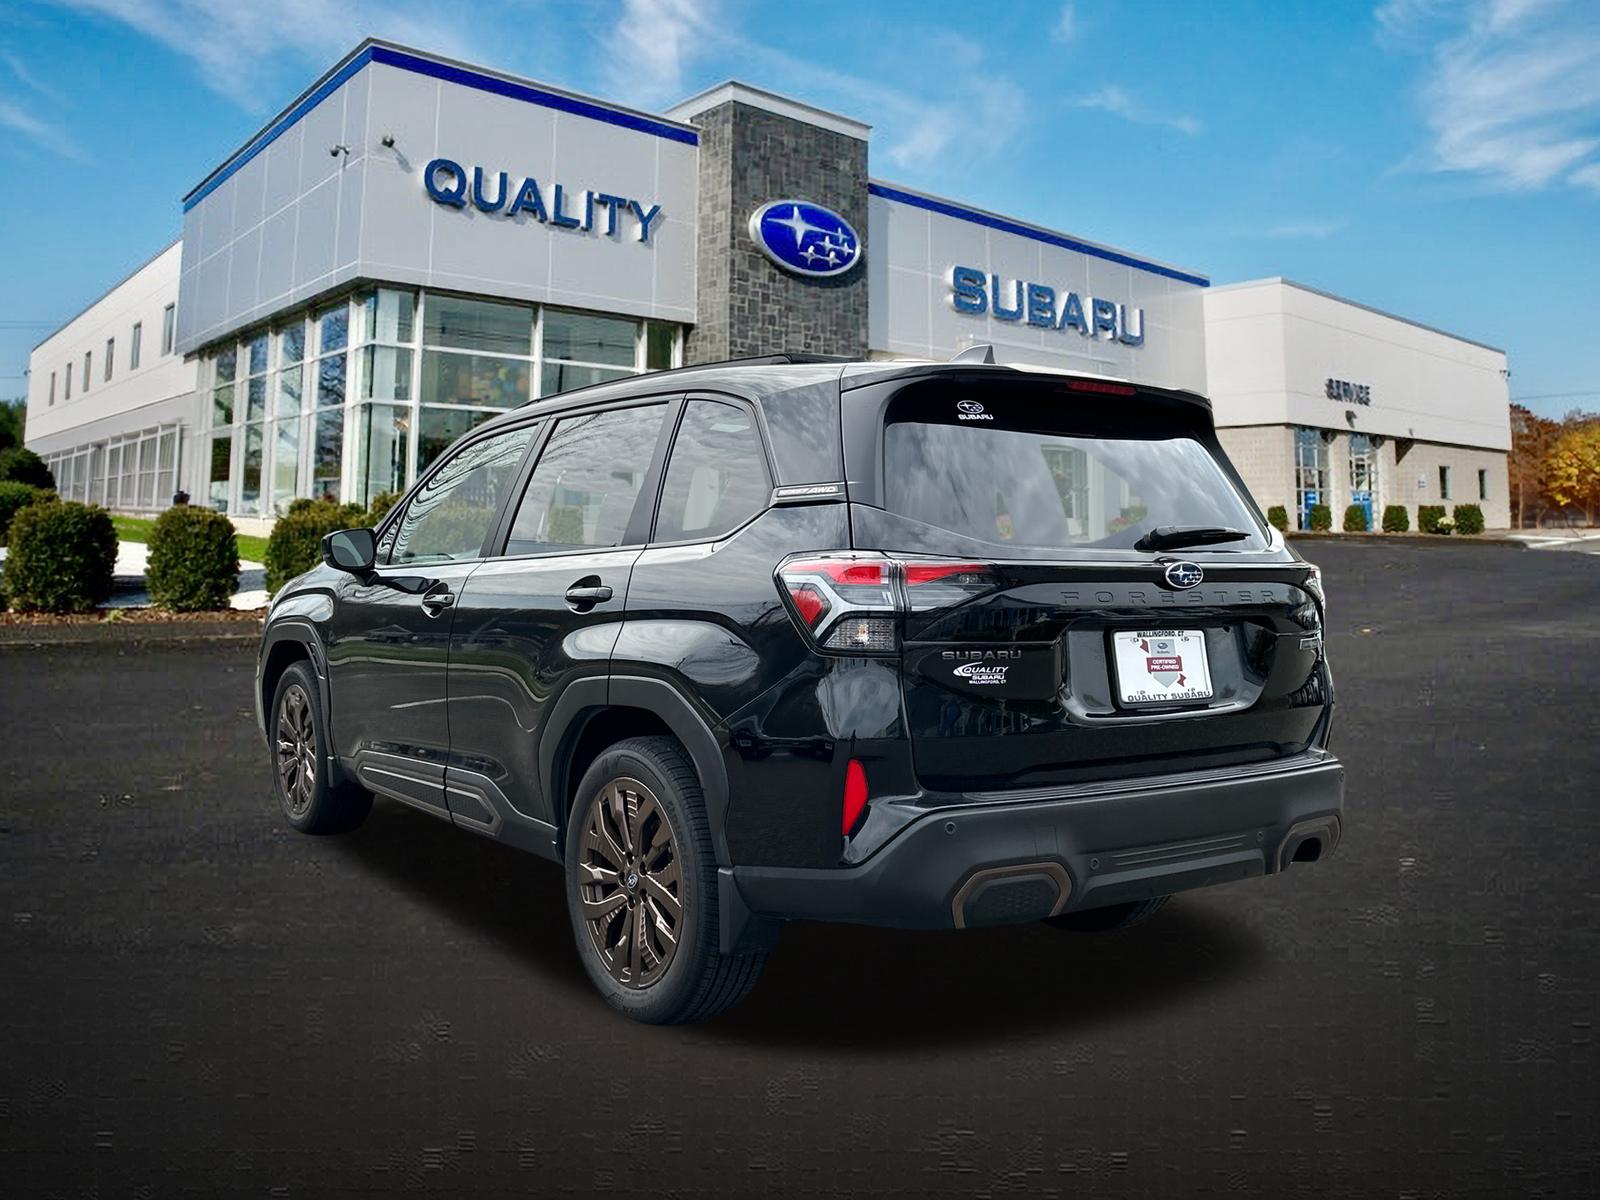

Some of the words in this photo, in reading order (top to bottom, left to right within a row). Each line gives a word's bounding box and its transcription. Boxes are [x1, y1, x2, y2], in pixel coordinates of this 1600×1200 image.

[424, 159, 661, 242] QUALITY
[952, 265, 1145, 346] SUBARU
[1325, 378, 1371, 406] SERVICE
[1060, 591, 1275, 604] FORESTER
[942, 650, 1021, 660] SUBARU
[1127, 693, 1168, 702] QUALITY
[1170, 691, 1211, 700] SUBARU
